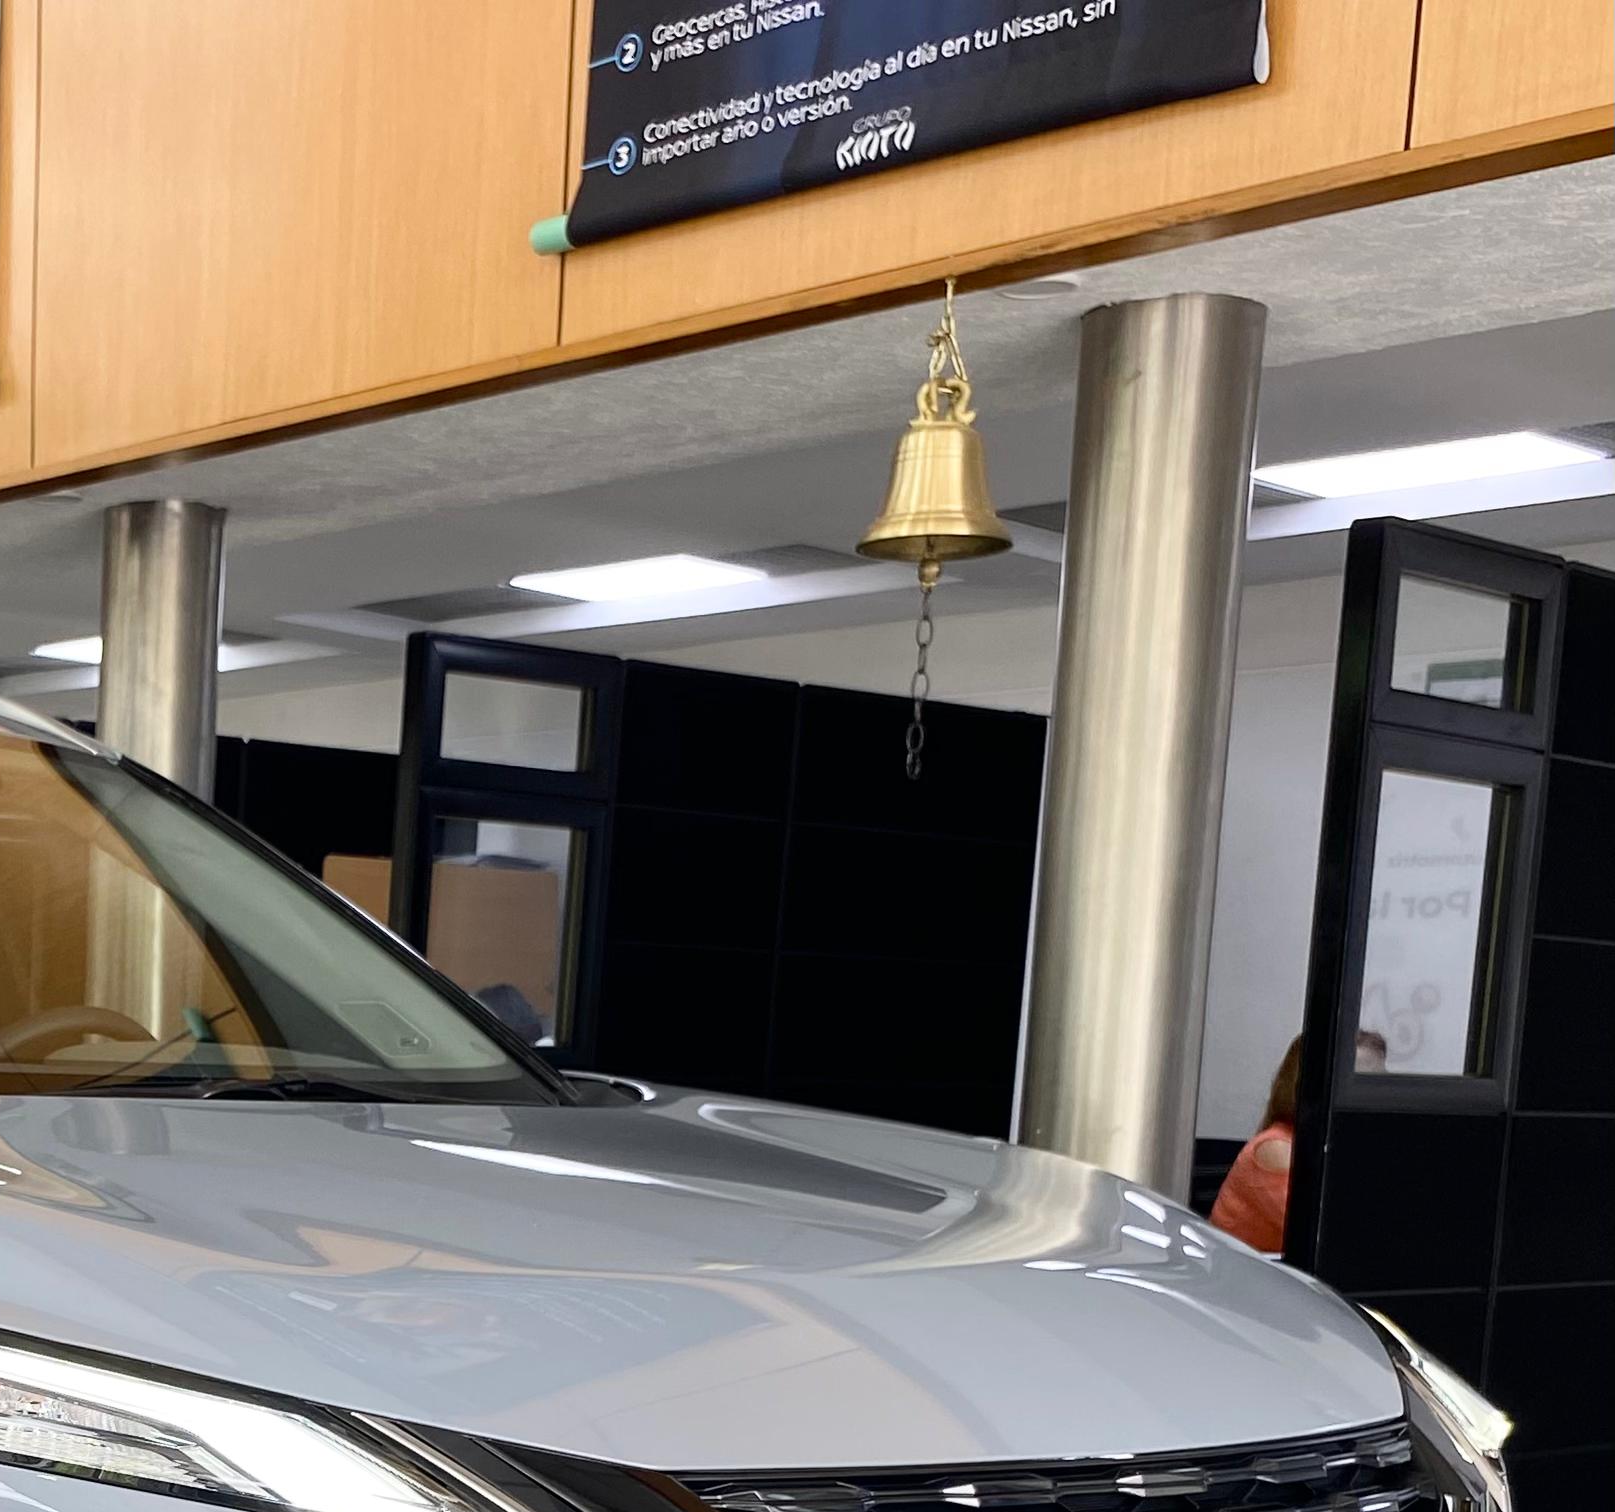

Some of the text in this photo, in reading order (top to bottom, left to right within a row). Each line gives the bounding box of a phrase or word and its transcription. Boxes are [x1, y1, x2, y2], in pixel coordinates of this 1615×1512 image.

[650, 50, 663, 72] y
[663, 36, 704, 62] más
[707, 30, 730, 51] en
[733, 21, 754, 42] tu
[756, 1, 825, 34] Nissan.
[652, 3, 748, 45] Geocercas,
[621, 42, 635, 65] 2
[643, 92, 760, 143] Conectividad
[763, 91, 774, 114] y
[884, 50, 903, 75] al
[906, 42, 937, 69] día
[941, 35, 970, 58] en
[974, 28, 997, 50] tu
[1002, 6, 1078, 43] Nissan,
[1082, 0, 1116, 22] sin
[641, 94, 853, 166] importar año o versión.
[852, 105, 912, 134] GRUPO
[614, 145, 630, 168] 3
